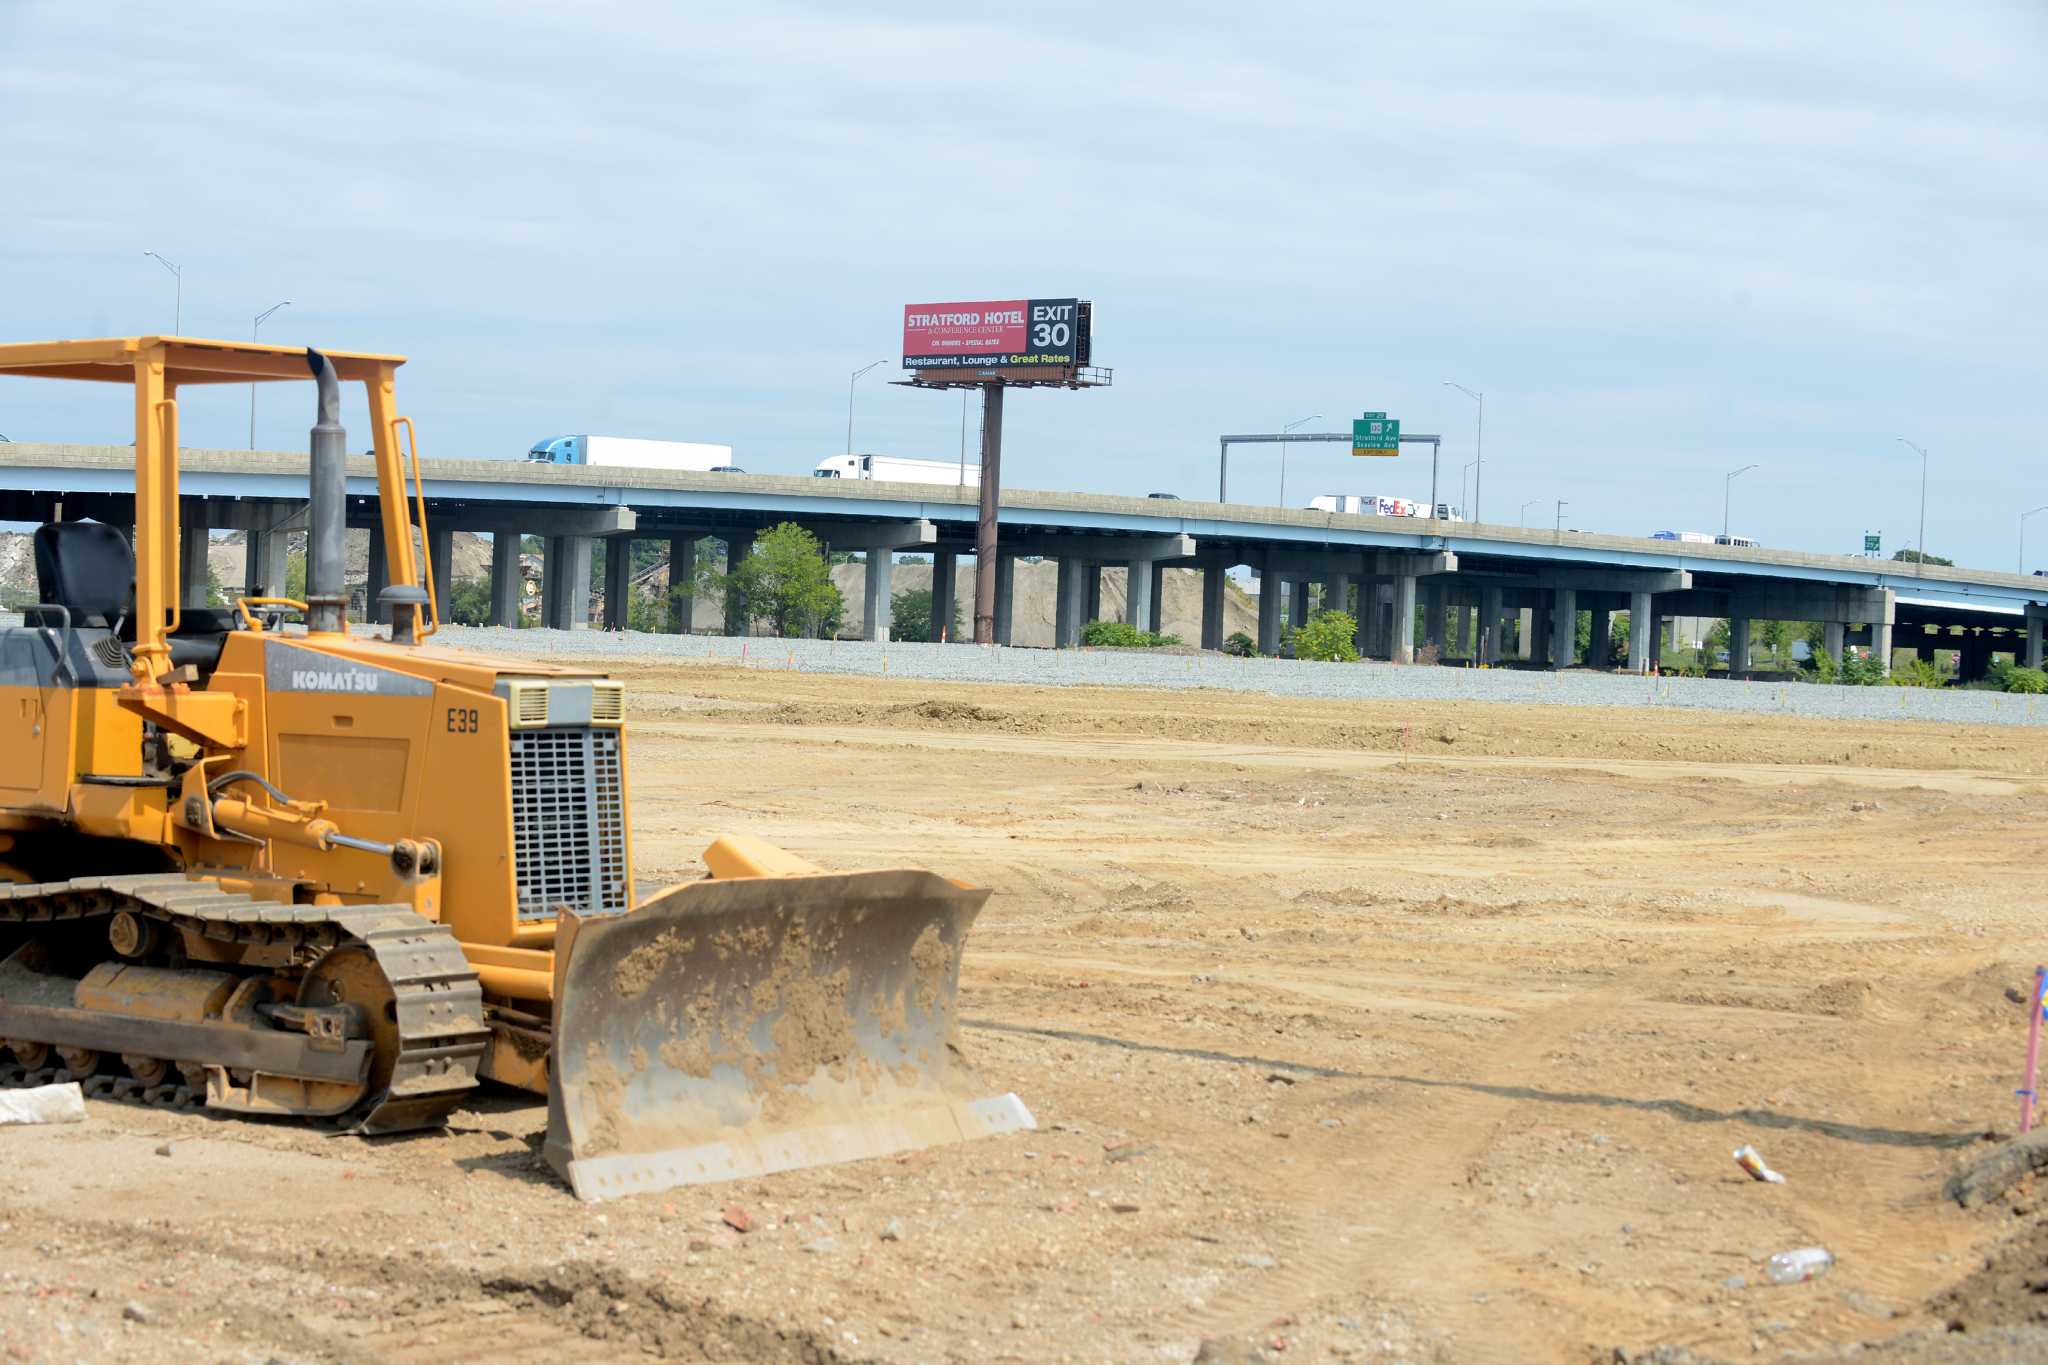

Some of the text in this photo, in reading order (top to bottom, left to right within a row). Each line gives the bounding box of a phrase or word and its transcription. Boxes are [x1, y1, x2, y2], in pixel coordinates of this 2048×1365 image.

[908, 311, 1025, 327] STRATFORD HOTEL
[1033, 305, 1072, 321] EXIT
[1033, 323, 1070, 347] 30
[905, 354, 1071, 367] Restaurant, Lounge & Great Rates
[1379, 498, 1407, 517] FedEx
[292, 668, 378, 692] KOMATSU
[447, 708, 478, 733] E39
